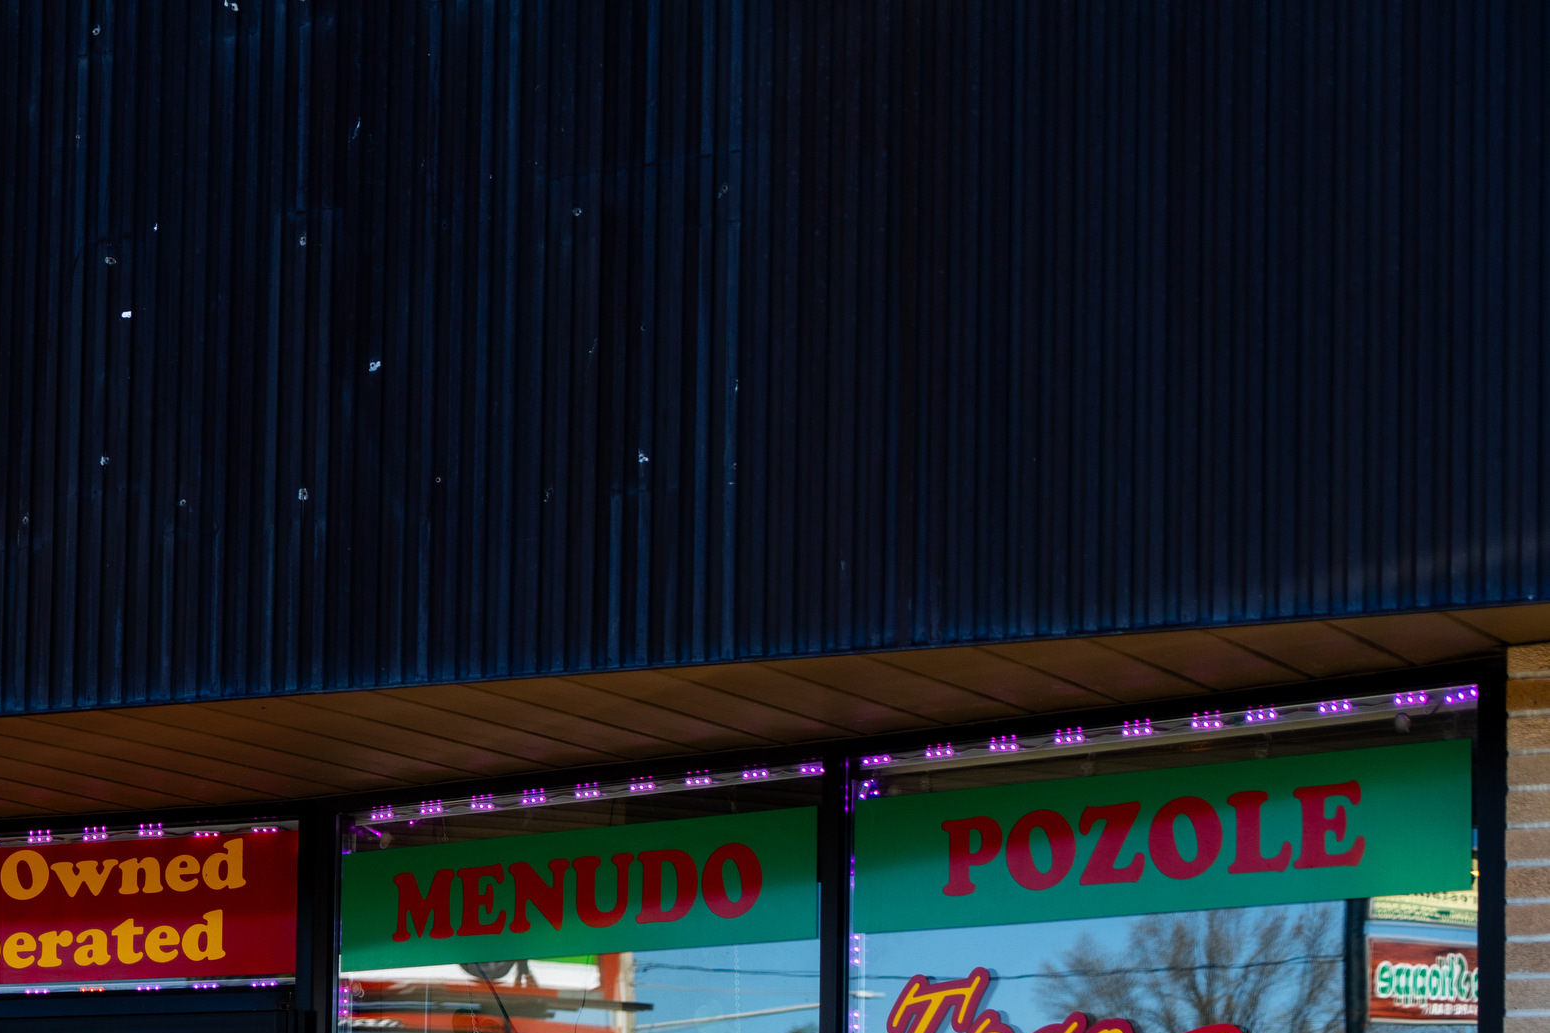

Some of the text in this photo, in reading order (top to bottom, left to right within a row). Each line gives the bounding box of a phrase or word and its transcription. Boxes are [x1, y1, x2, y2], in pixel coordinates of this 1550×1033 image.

[0, 839, 247, 900] Owned
[941, 780, 1366, 897] POZOLE
[392, 842, 763, 942] MENUDO
